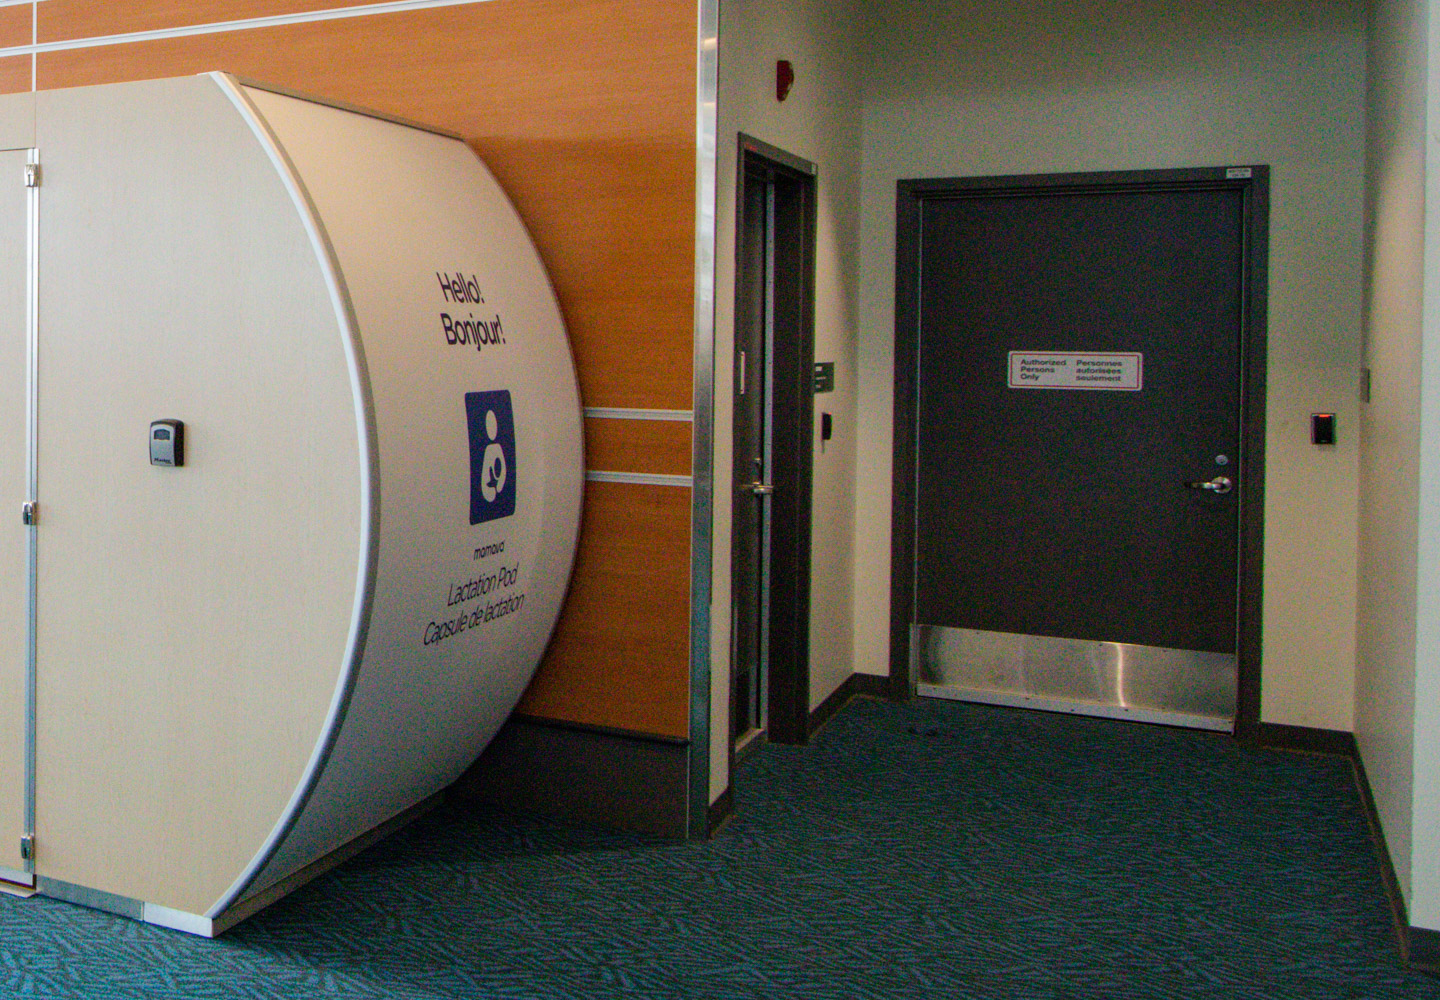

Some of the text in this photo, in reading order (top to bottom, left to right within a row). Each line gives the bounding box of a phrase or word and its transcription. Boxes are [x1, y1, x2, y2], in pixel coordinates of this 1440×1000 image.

[436, 271, 485, 304] Hello!
[440, 312, 506, 352] Bonjour!
[1020, 373, 1040, 381] Only
[1076, 374, 1122, 382] seulement
[447, 562, 520, 607] Lactation Pod
[423, 592, 525, 646] Capsule de lactation
